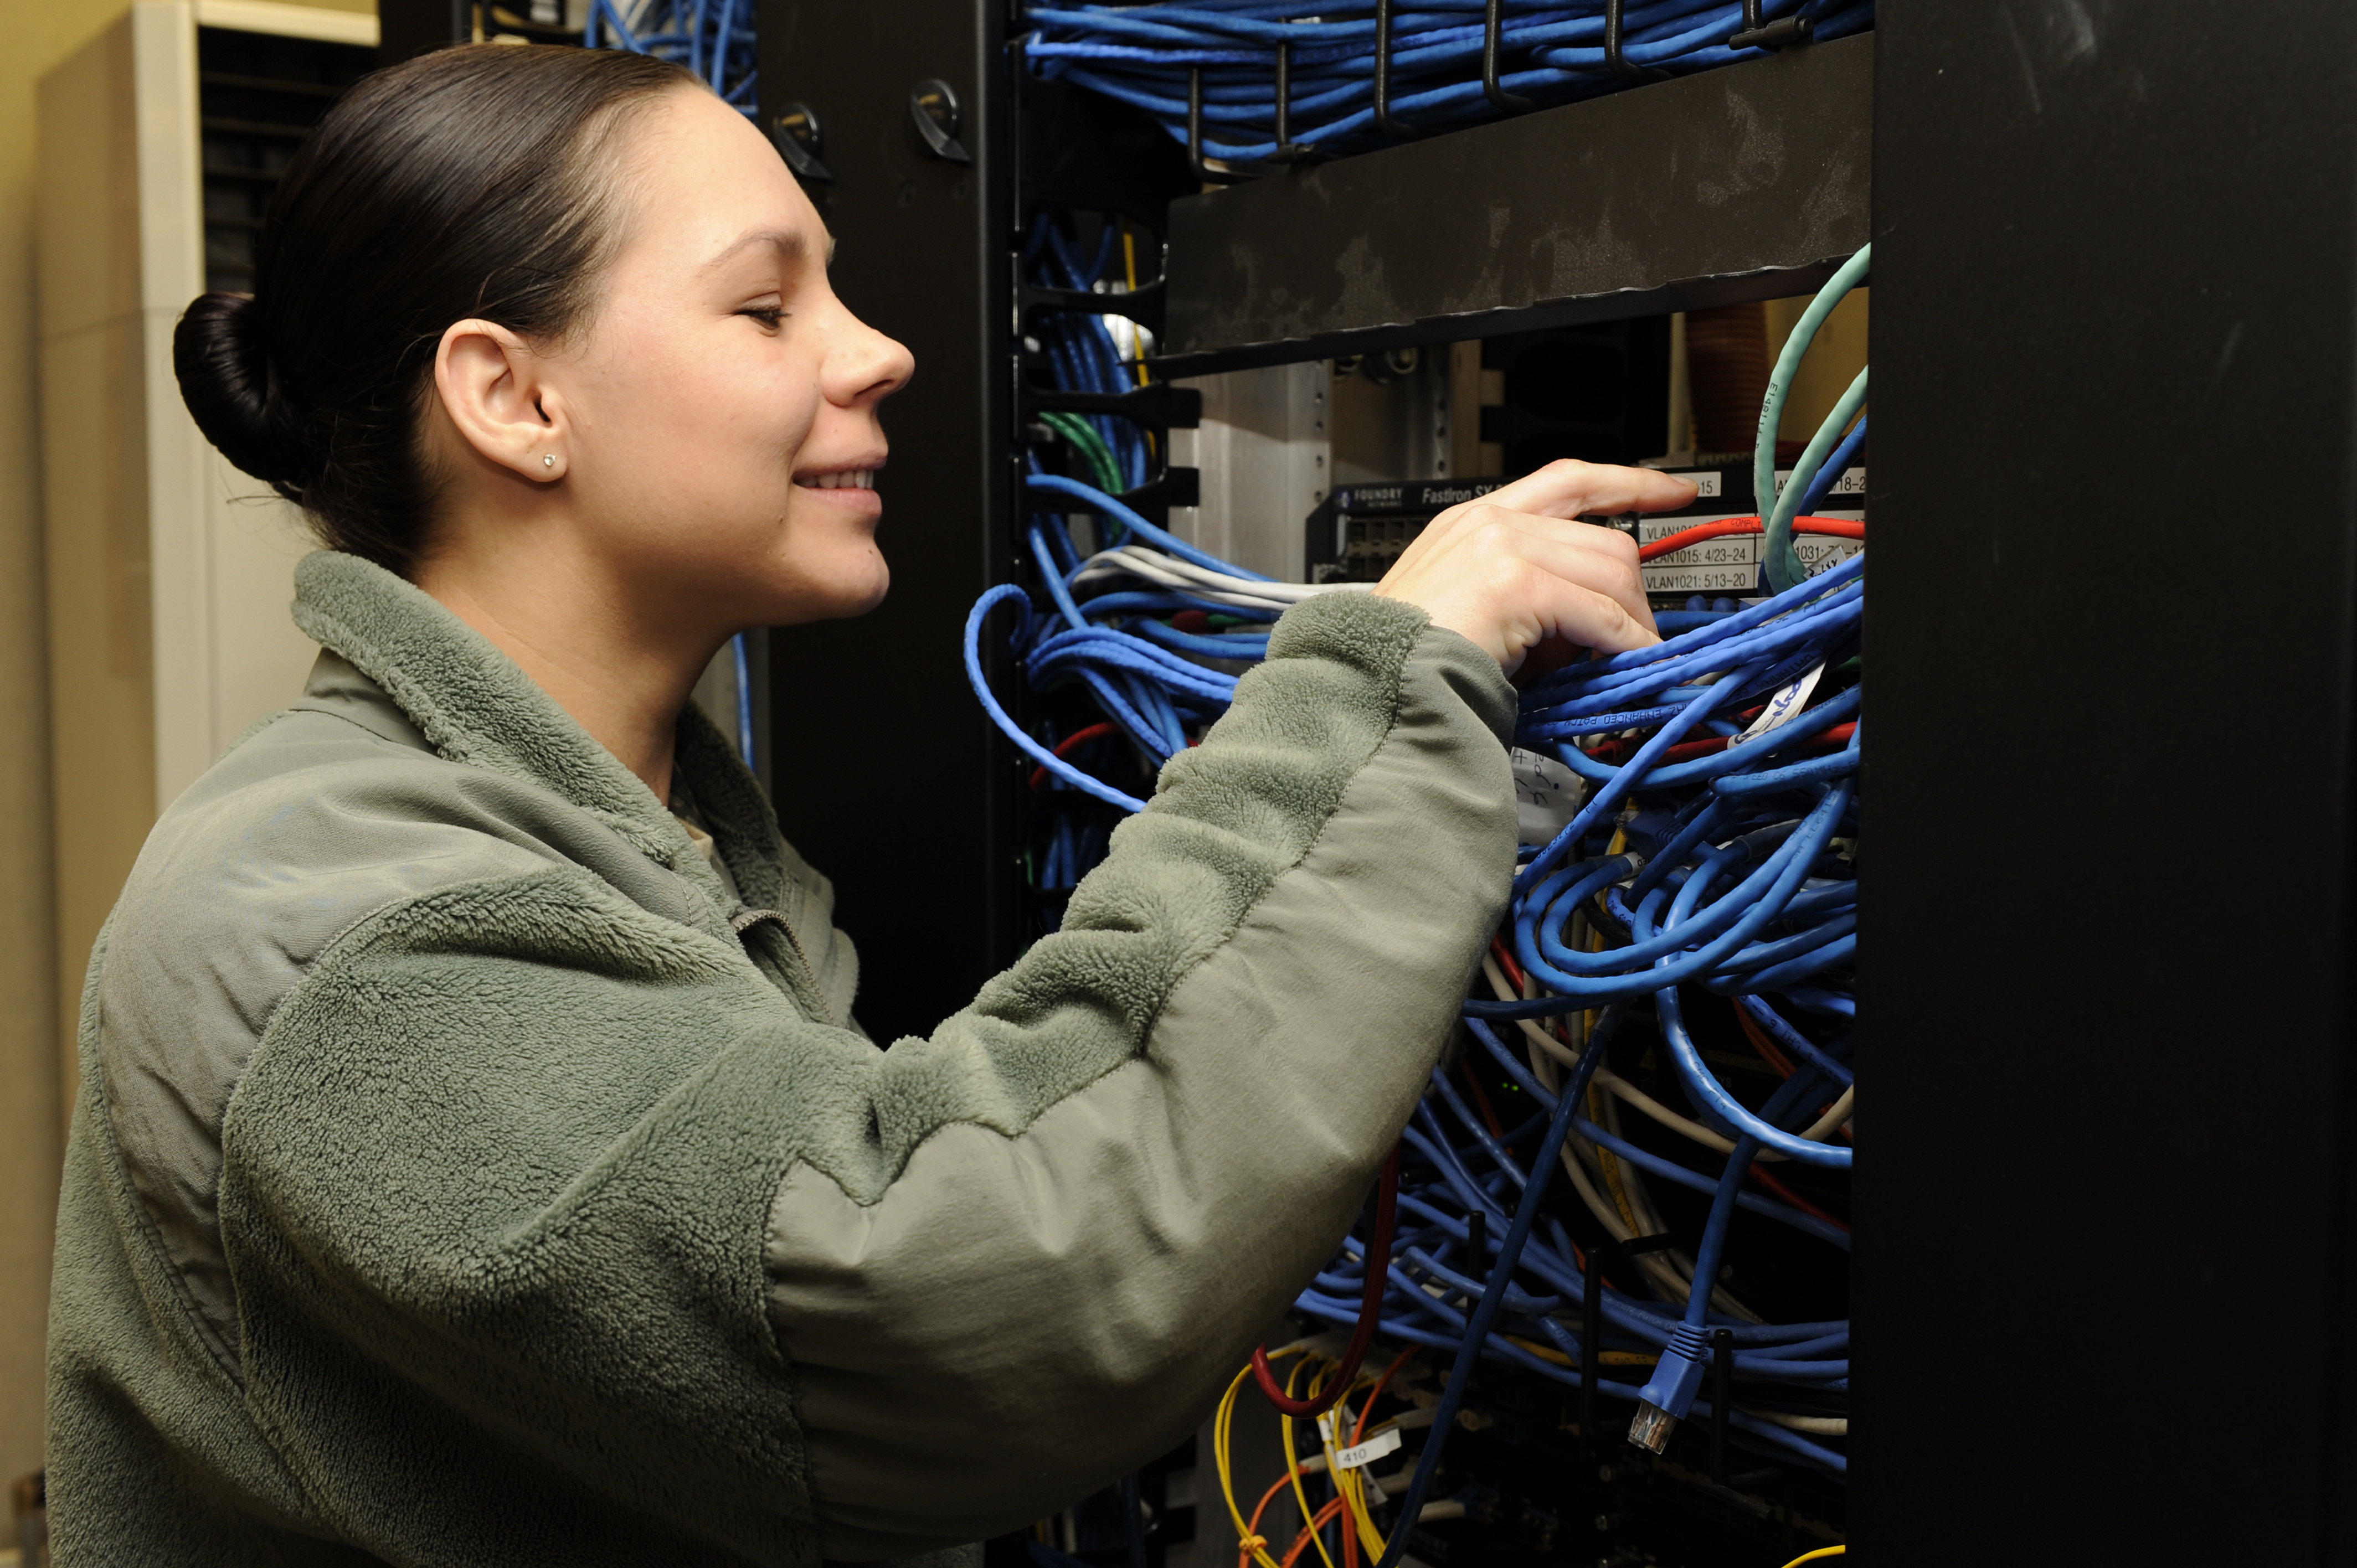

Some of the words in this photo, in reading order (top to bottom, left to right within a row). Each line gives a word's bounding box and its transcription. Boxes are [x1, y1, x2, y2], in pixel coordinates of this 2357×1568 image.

[1354, 487, 1403, 501] FOUNDRY
[1705, 548, 1746, 561] 4/23-24
[1646, 574, 1701, 589] VLAN1021:
[1704, 572, 1746, 587] 5/13-20
[1603, 709, 1663, 725] ENHANCED
